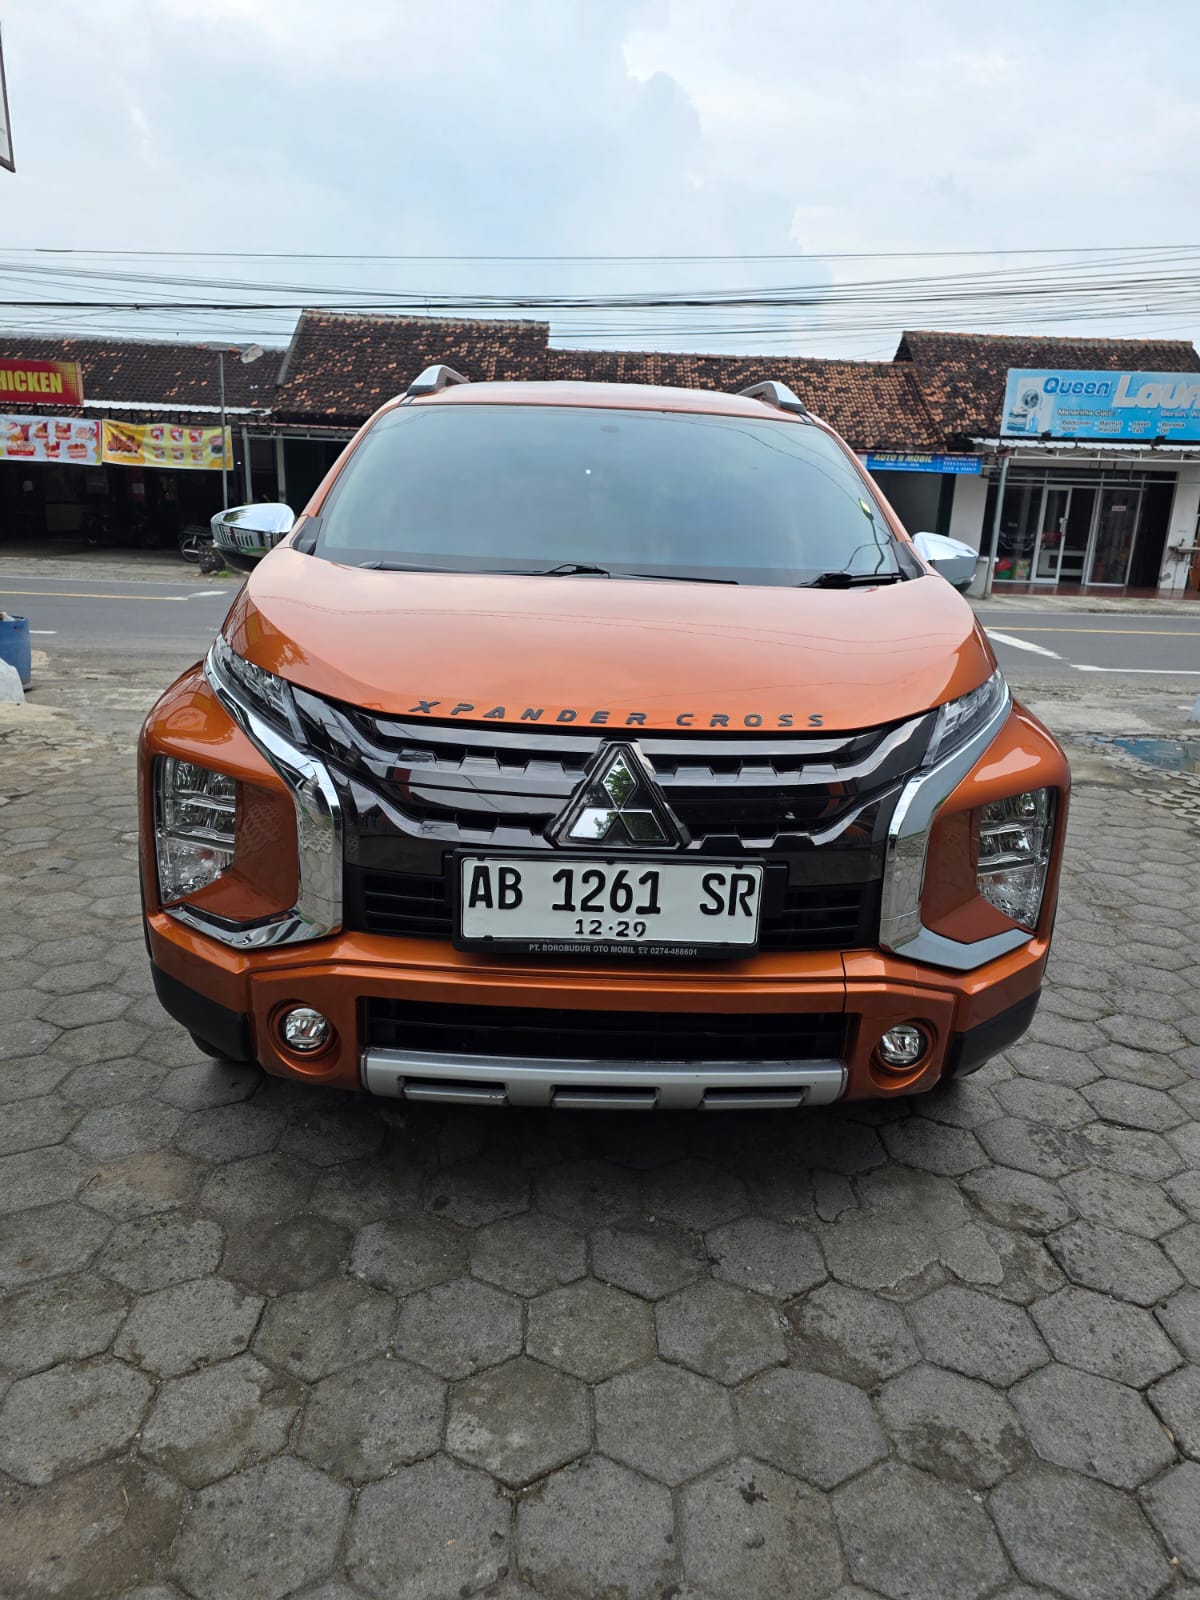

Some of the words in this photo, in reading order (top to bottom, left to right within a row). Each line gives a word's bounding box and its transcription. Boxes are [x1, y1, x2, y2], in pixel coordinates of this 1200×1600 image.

[1043, 376, 1111, 396] Queen
[873, 454, 897, 462] AUTO
[905, 455, 933, 463] MOBIL
[408, 701, 647, 726] XPANDER
[675, 713, 824, 727] CROSS
[468, 865, 523, 910] AB
[551, 868, 661, 915] 1261
[699, 872, 756, 917] SR
[528, 943, 540, 952] PT.
[542, 944, 591, 953] BOROBUDUR
[592, 945, 609, 953] OTO
[610, 946, 636, 954] MOBIL
